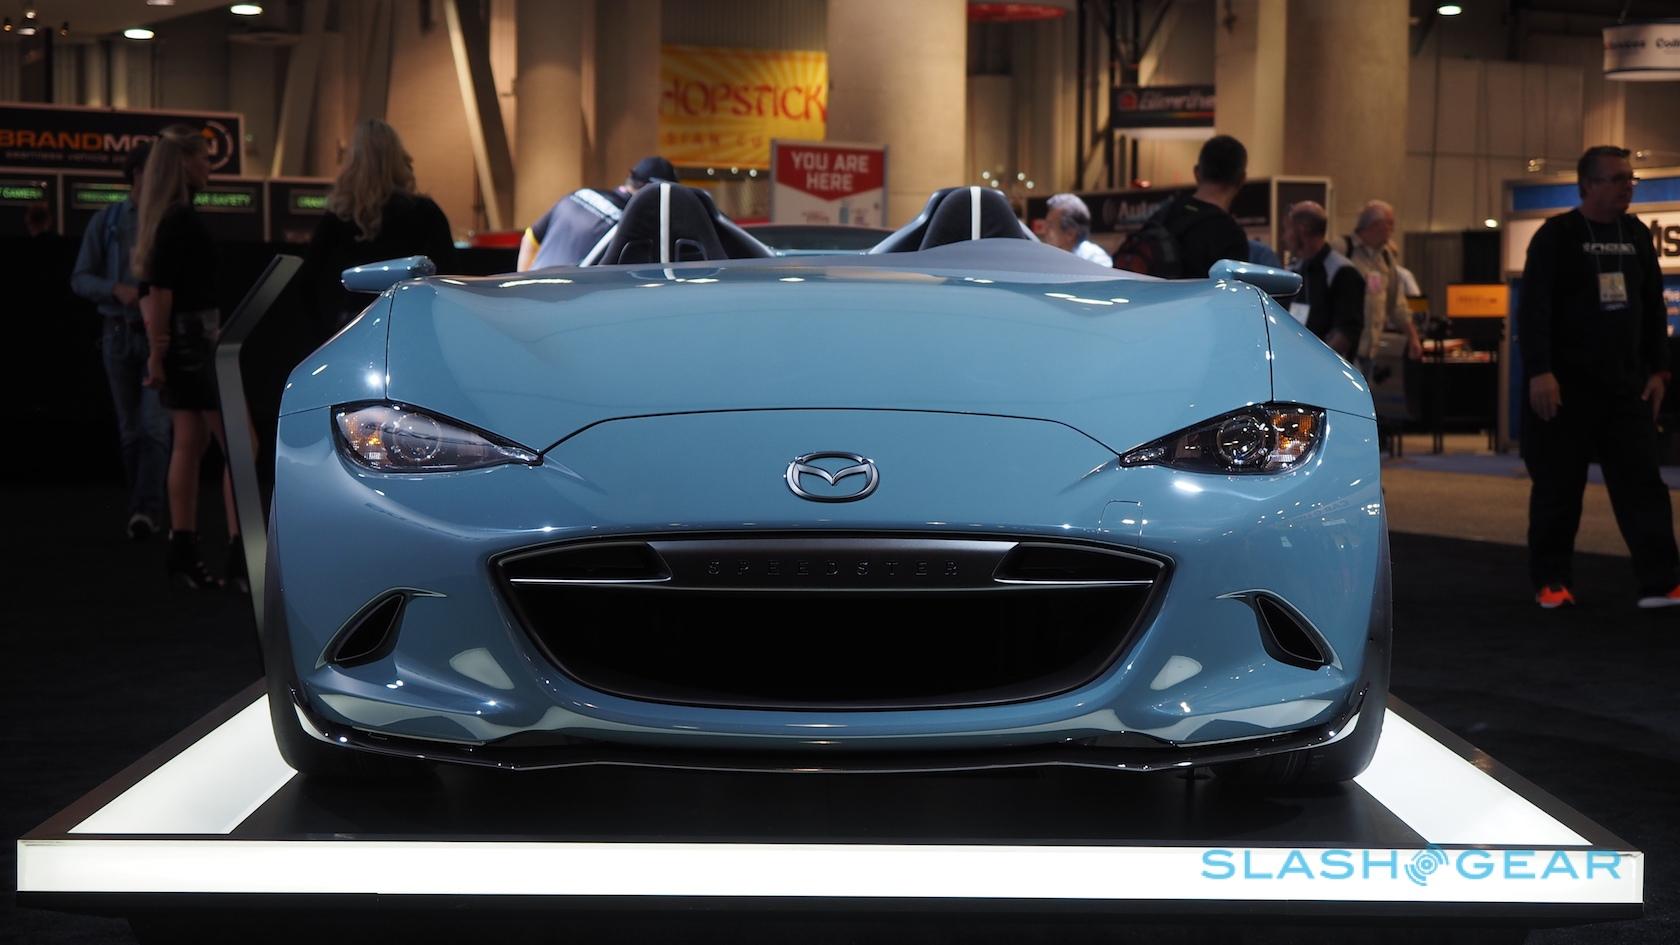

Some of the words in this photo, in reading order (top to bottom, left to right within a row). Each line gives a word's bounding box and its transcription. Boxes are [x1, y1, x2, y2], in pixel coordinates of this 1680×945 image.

[791, 151, 829, 171] YOU
[834, 152, 870, 173] ARE
[805, 171, 853, 191] HERE
[707, 560, 959, 576] SPEEDSTER
